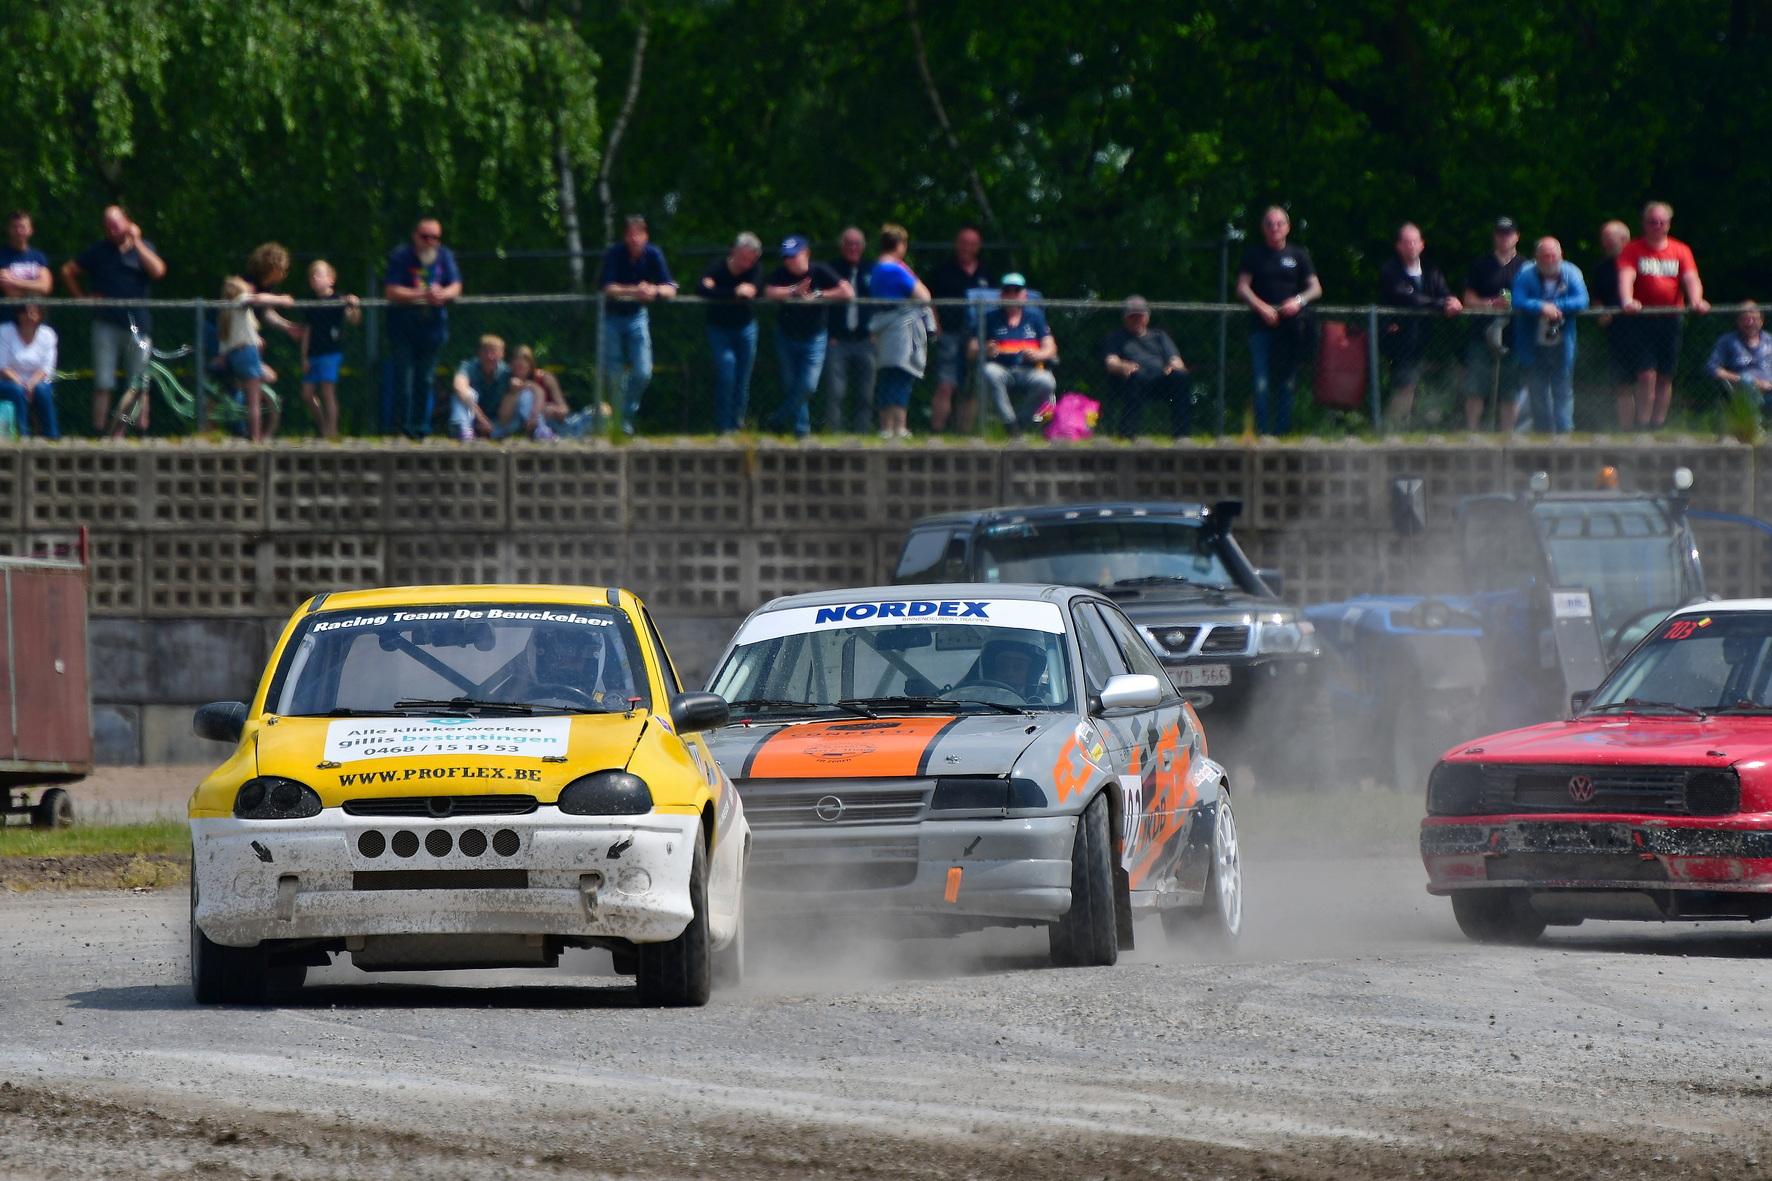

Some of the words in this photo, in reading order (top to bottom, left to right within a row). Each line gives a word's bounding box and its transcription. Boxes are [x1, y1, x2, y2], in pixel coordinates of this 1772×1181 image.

[313, 615, 389, 633] Racing
[393, 611, 450, 622] Team
[453, 609, 484, 620] De
[487, 609, 614, 627] Beuckelaer
[815, 601, 992, 625] NORDEX
[347, 728, 388, 736] Alle
[338, 736, 396, 748] gillis
[402, 734, 558, 744] bestratingen
[364, 746, 415, 756] 0468
[338, 766, 542, 786] WWW.PROFLEX.BE
